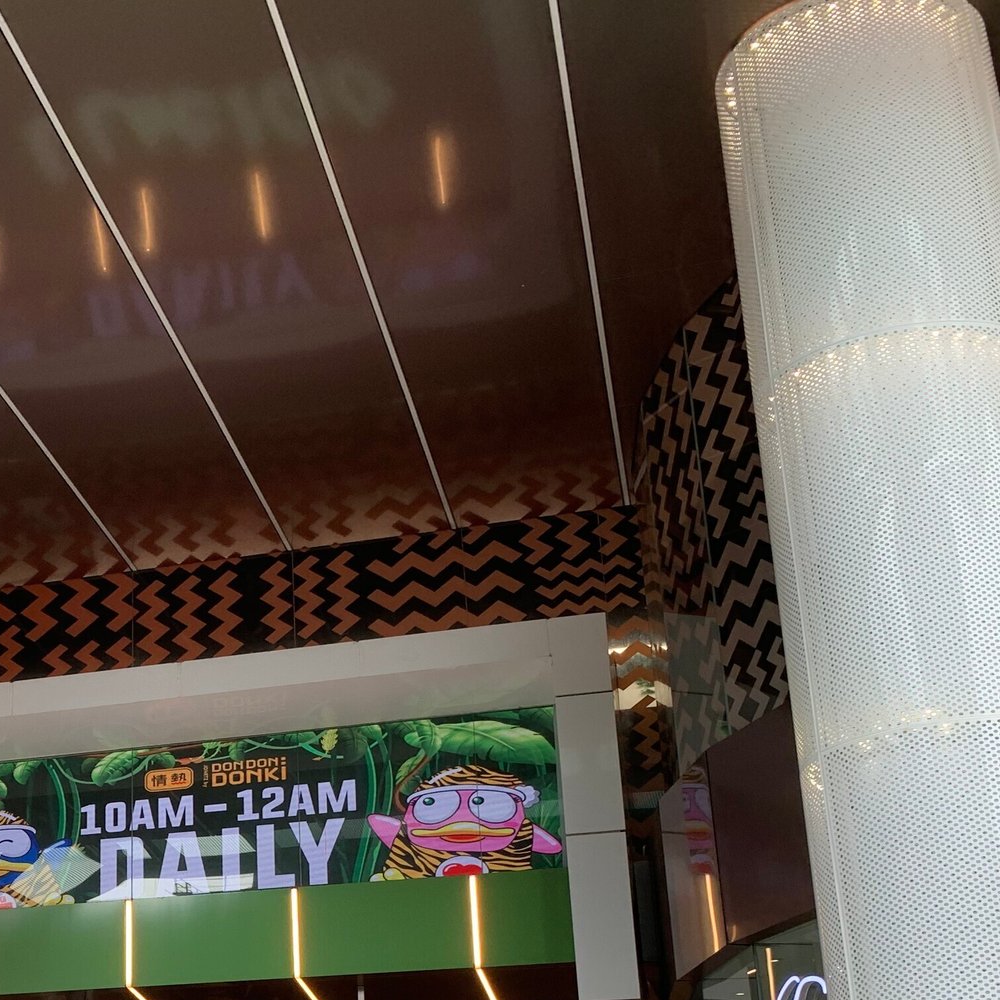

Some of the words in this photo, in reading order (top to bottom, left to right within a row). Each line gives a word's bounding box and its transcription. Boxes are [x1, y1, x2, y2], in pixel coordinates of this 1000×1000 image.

[80, 795, 194, 836] 10AM
[236, 779, 358, 822] 12AM
[100, 817, 345, 900] DAILY
